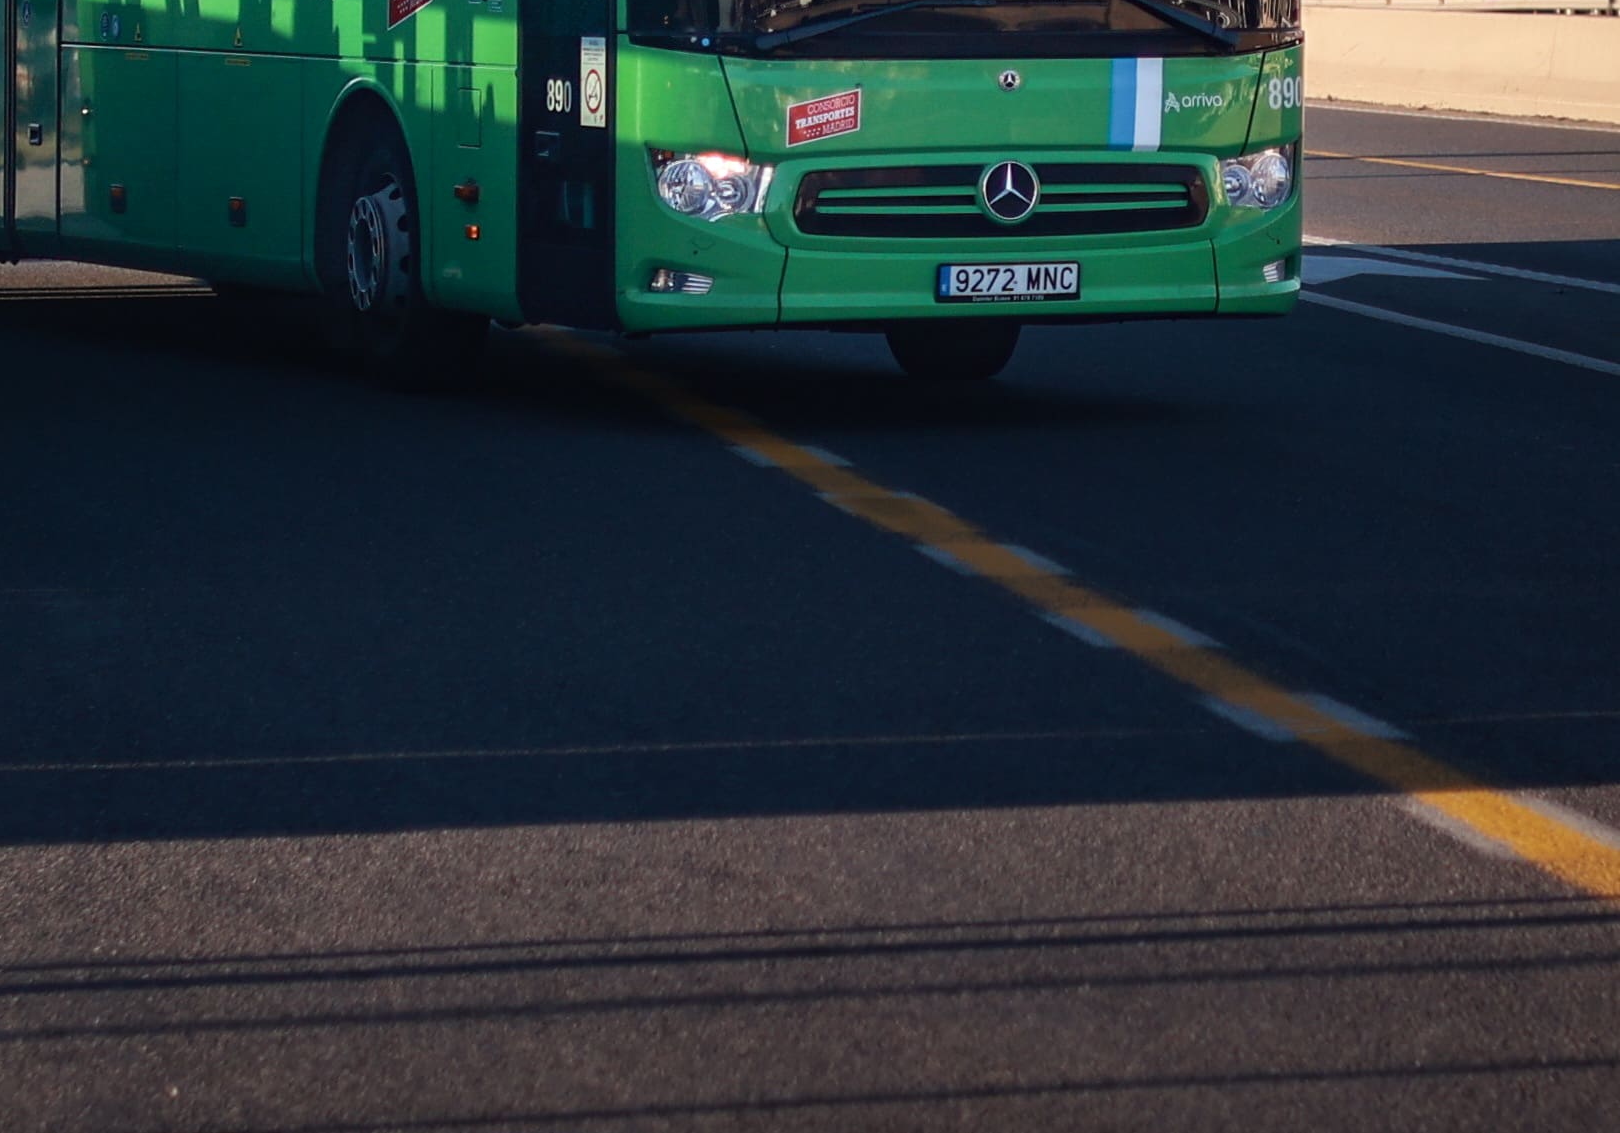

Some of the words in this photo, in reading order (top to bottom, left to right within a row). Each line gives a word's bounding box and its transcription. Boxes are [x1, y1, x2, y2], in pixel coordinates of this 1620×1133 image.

[546, 78, 572, 113] 890
[1181, 91, 1223, 108] arriva
[795, 106, 855, 130] TRANSPORTES
[822, 118, 855, 135] MADRID
[955, 268, 1016, 293] 9272
[1026, 266, 1073, 292] MNC
